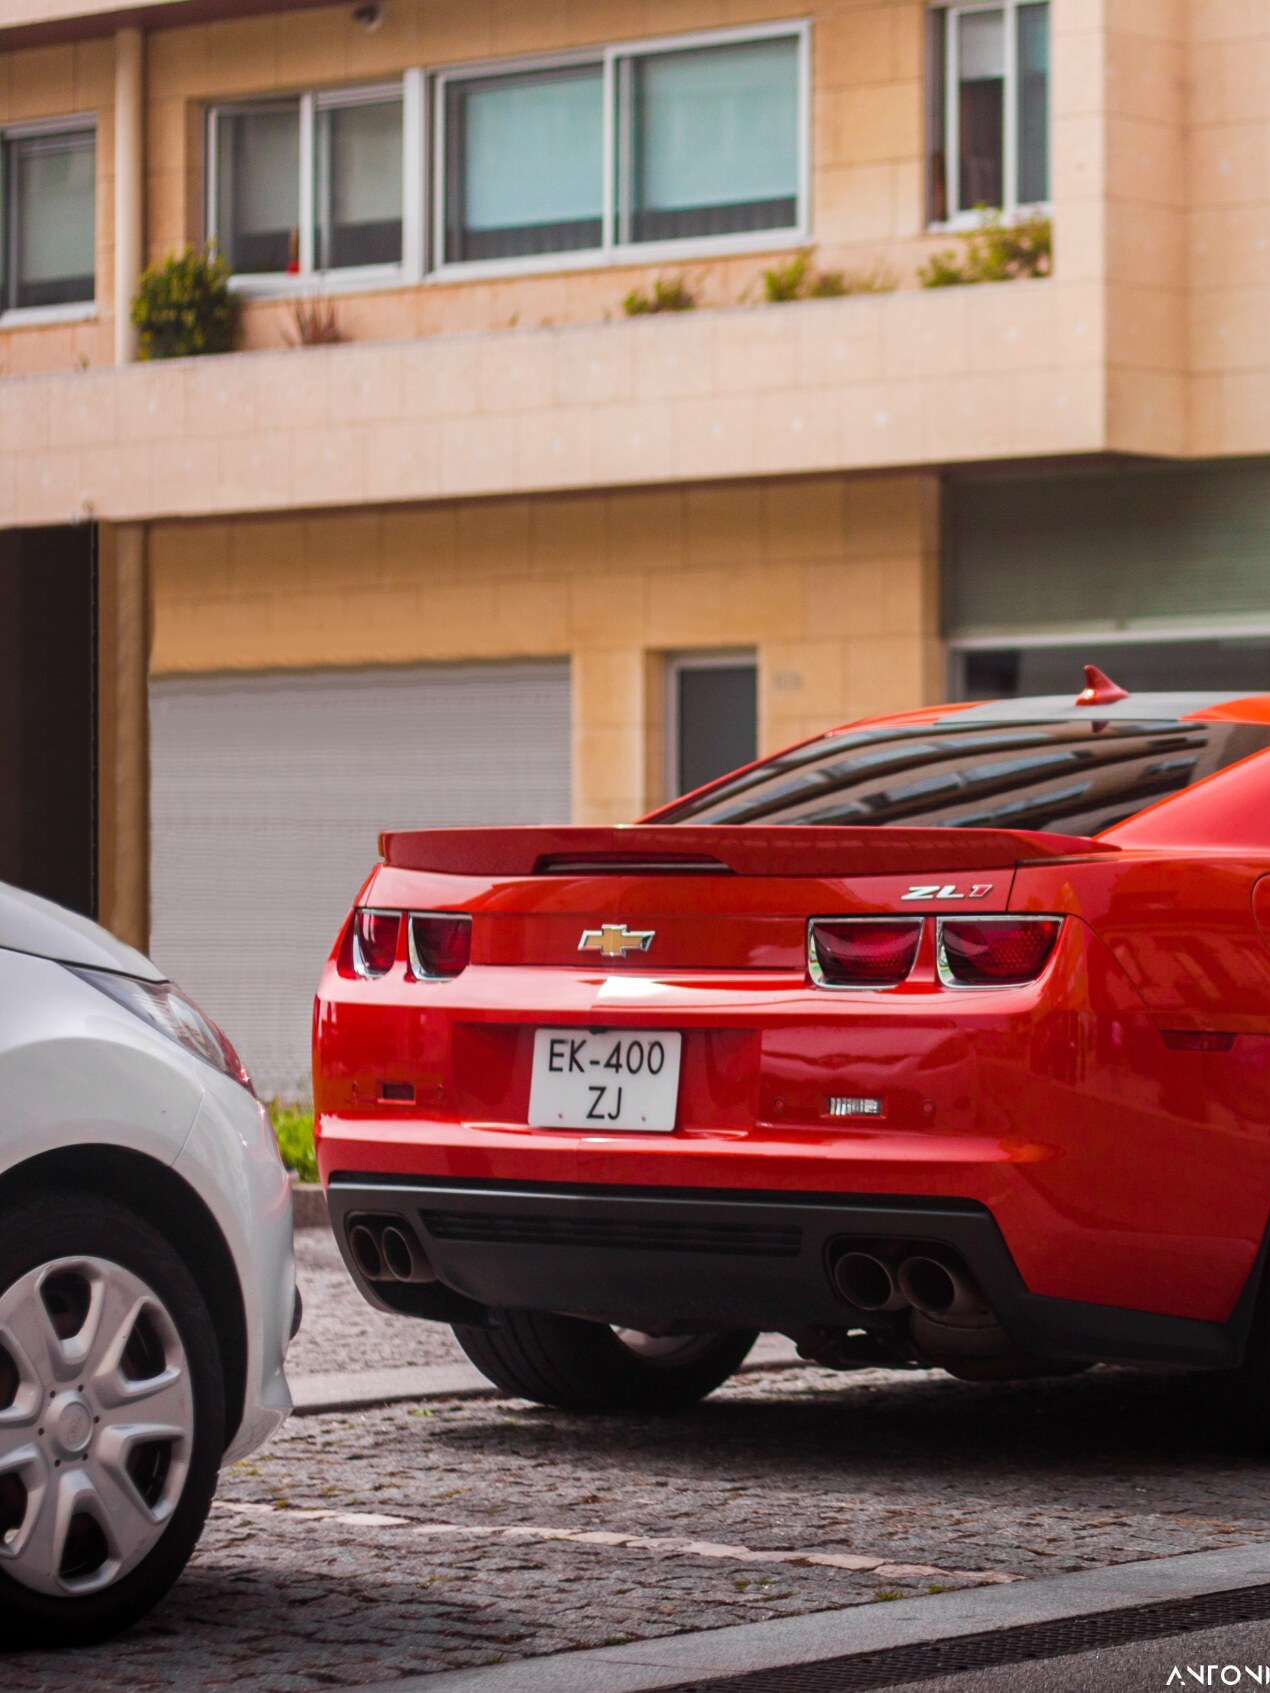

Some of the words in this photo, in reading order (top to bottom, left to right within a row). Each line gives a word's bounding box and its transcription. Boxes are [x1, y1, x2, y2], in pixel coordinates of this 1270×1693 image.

[901, 884, 993, 900] ZL1
[548, 1038, 665, 1075] EK-400
[586, 1086, 622, 1121] ZJ
